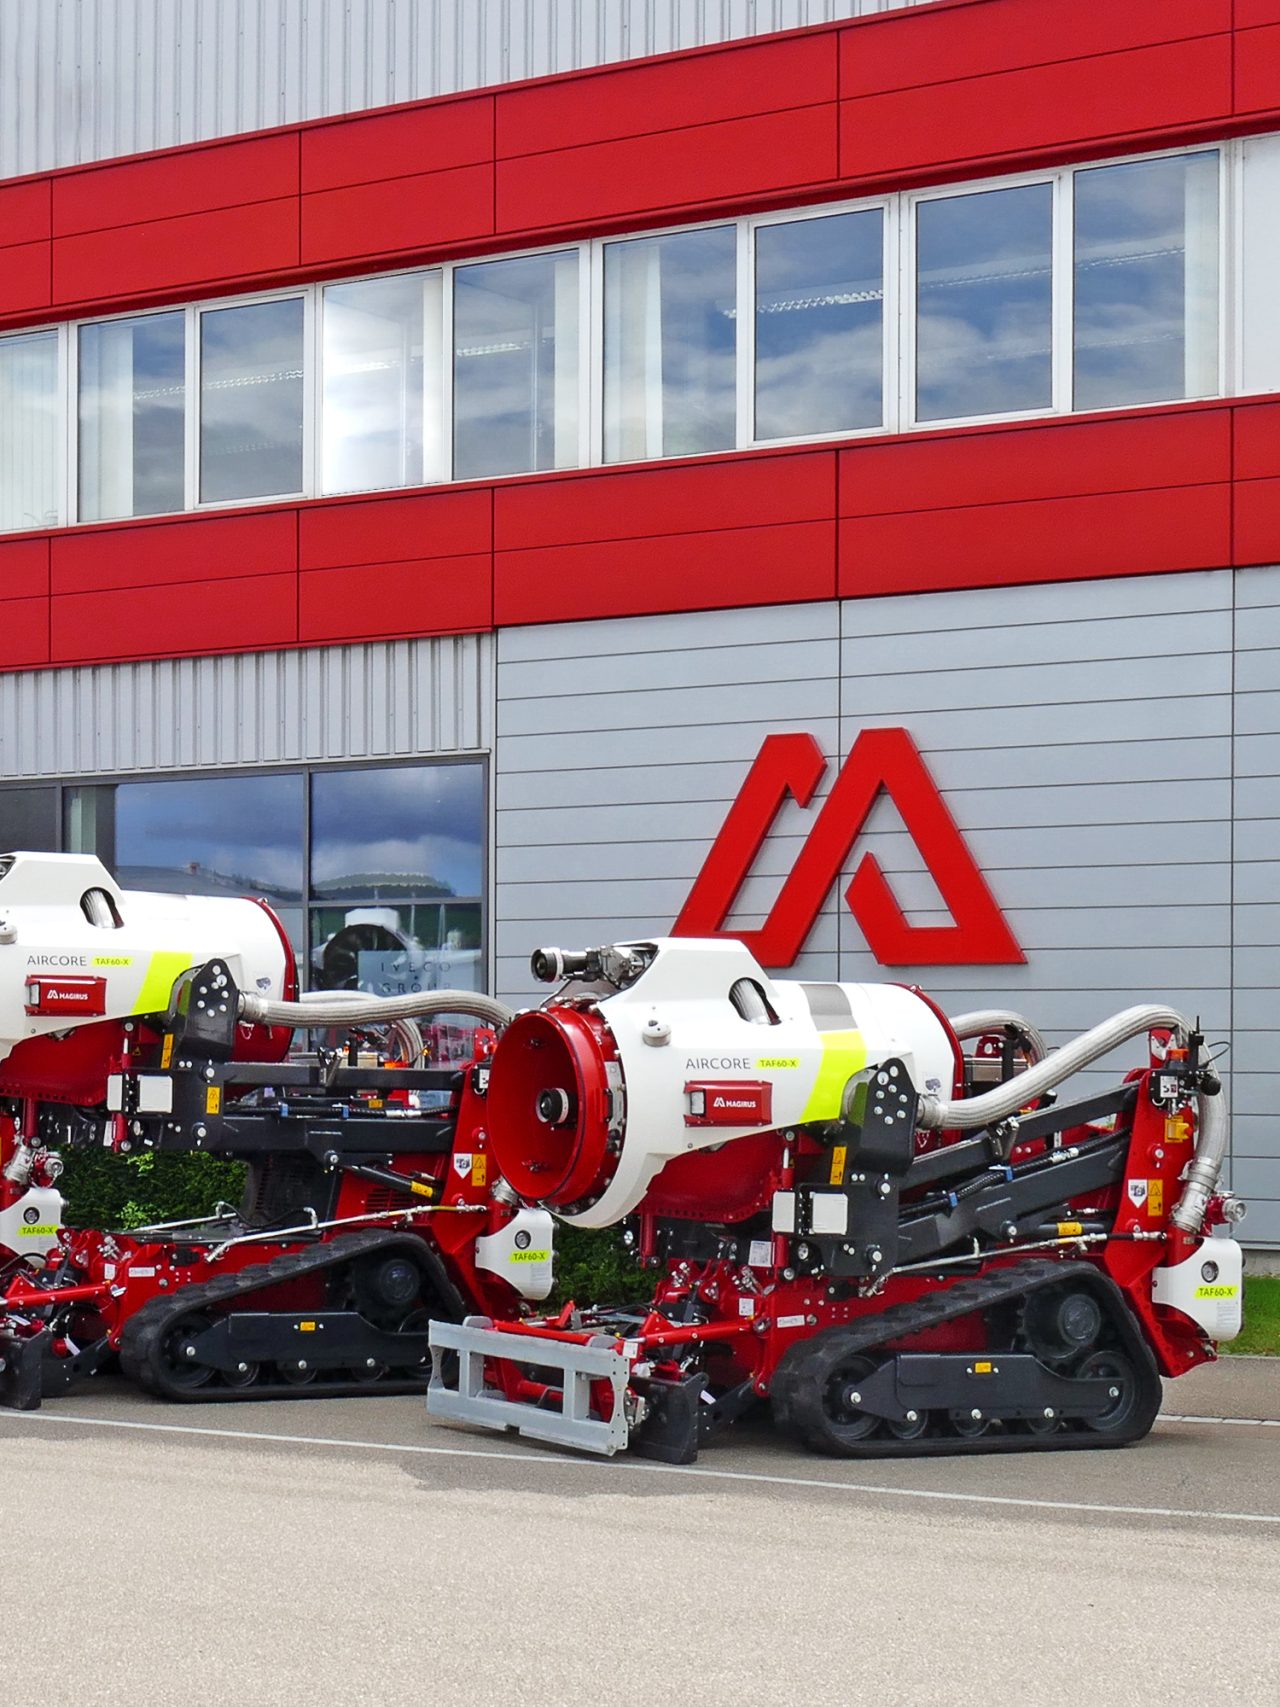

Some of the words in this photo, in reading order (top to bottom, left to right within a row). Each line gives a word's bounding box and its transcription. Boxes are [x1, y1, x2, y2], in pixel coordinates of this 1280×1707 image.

[27, 955, 87, 966] AIRCORE
[95, 958, 129, 966] TAF60-X
[380, 961, 451, 973] IVECO
[685, 1058, 751, 1070] AIRCORE
[726, 1100, 756, 1108] MAGIRUS
[513, 1252, 545, 1261] TAF60-X
[1198, 1287, 1233, 1296] TAF60-X
